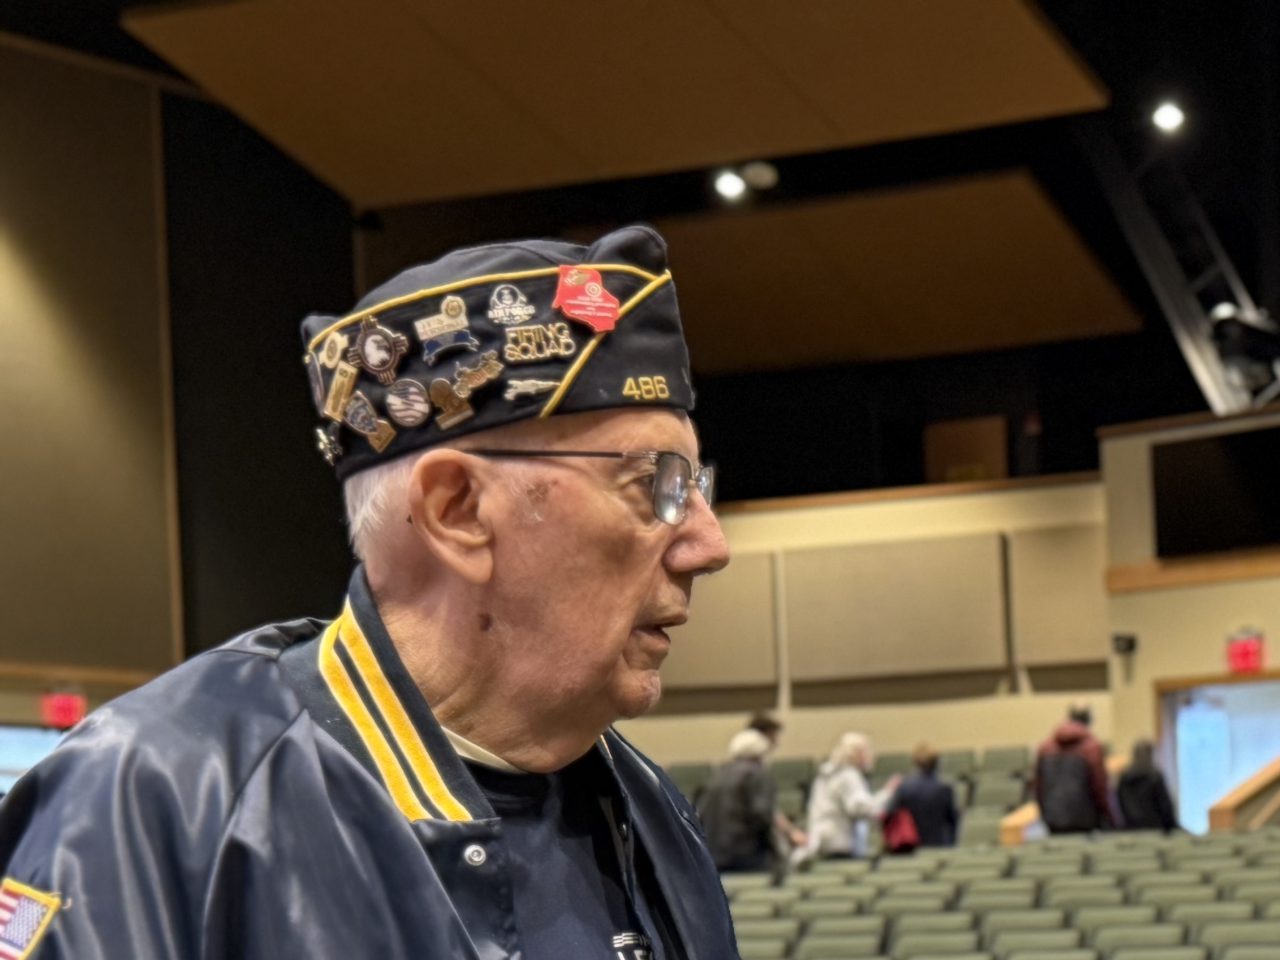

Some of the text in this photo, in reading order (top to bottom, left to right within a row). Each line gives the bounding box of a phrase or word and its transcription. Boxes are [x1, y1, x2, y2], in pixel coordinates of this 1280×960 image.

[505, 322, 569, 344] FIRING
[504, 338, 576, 361] SQUAD
[622, 375, 670, 400] 486
